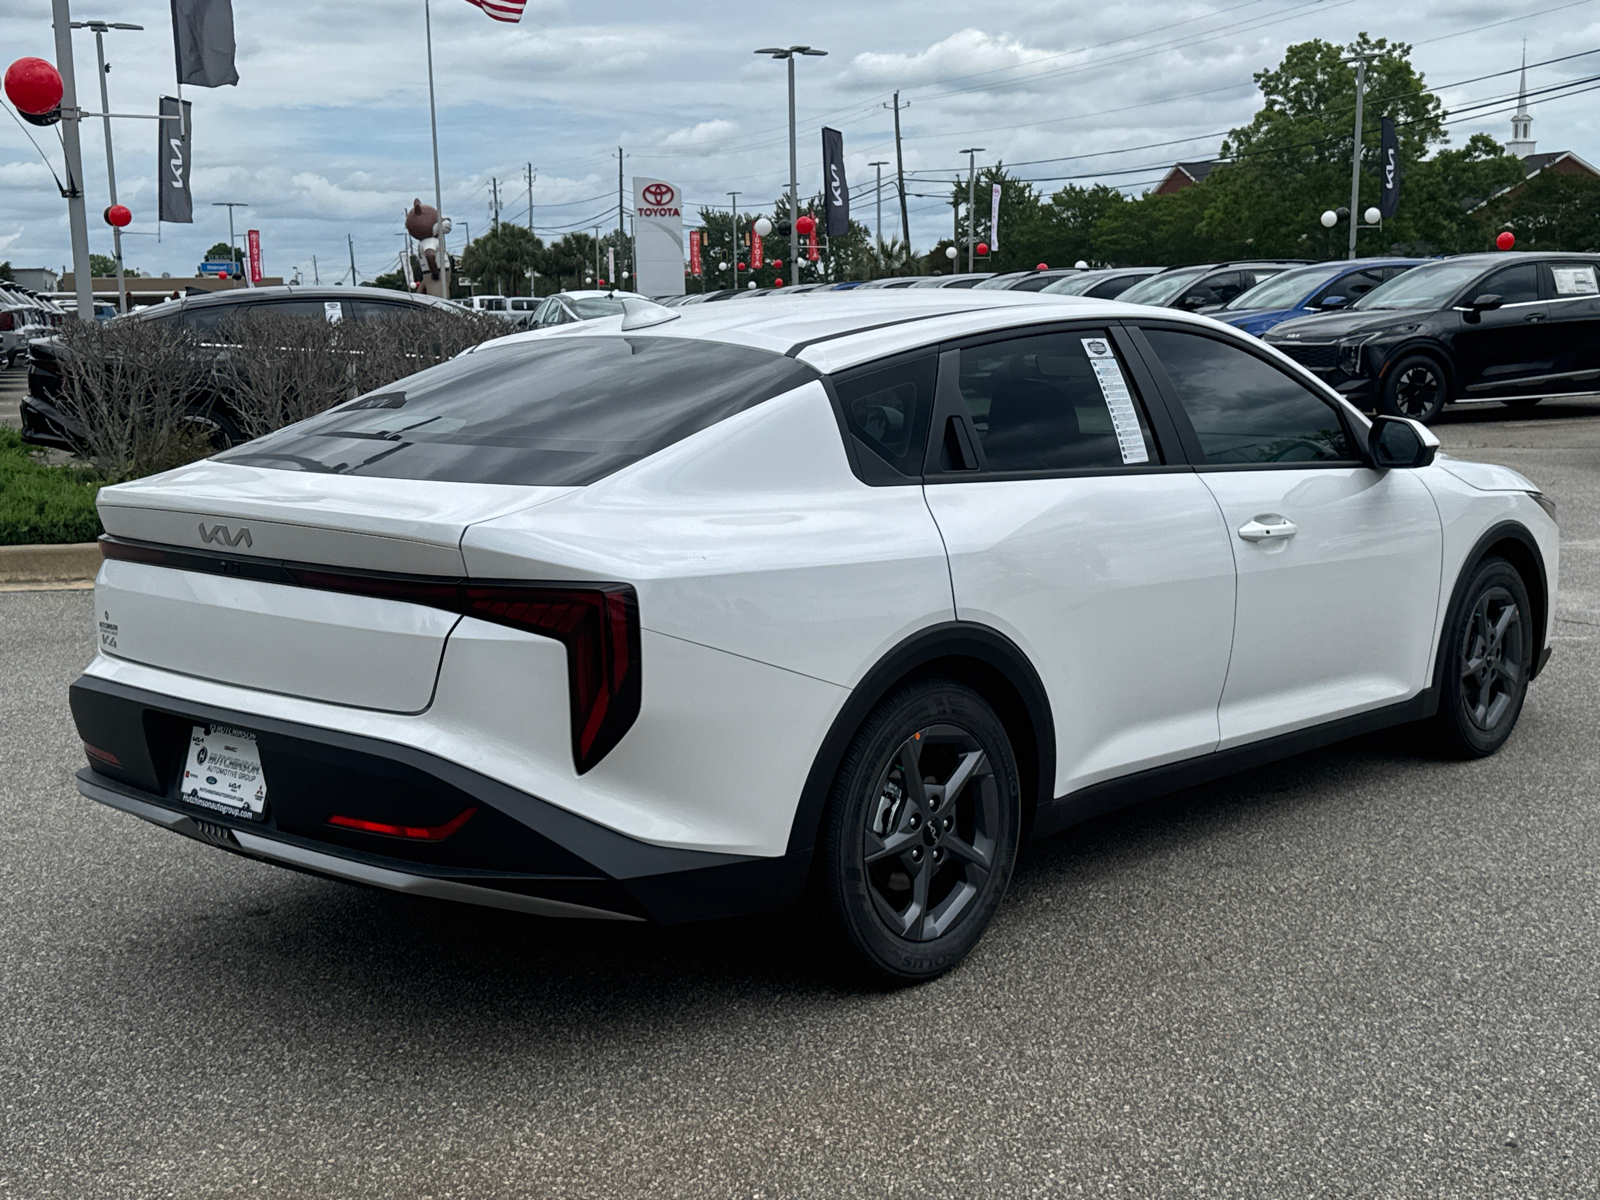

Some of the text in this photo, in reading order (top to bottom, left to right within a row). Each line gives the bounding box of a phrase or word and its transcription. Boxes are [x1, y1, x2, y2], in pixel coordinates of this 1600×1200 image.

[170, 138, 183, 188] KIA
[637, 207, 680, 217] TOYOTA
[252, 241, 260, 281] TOYOTA
[198, 522, 253, 549] KIA
[102, 633, 117, 649] K4
[206, 764, 256, 783] AUTOMOTIVE GROUP
[207, 752, 261, 775] HUTCHINSON
